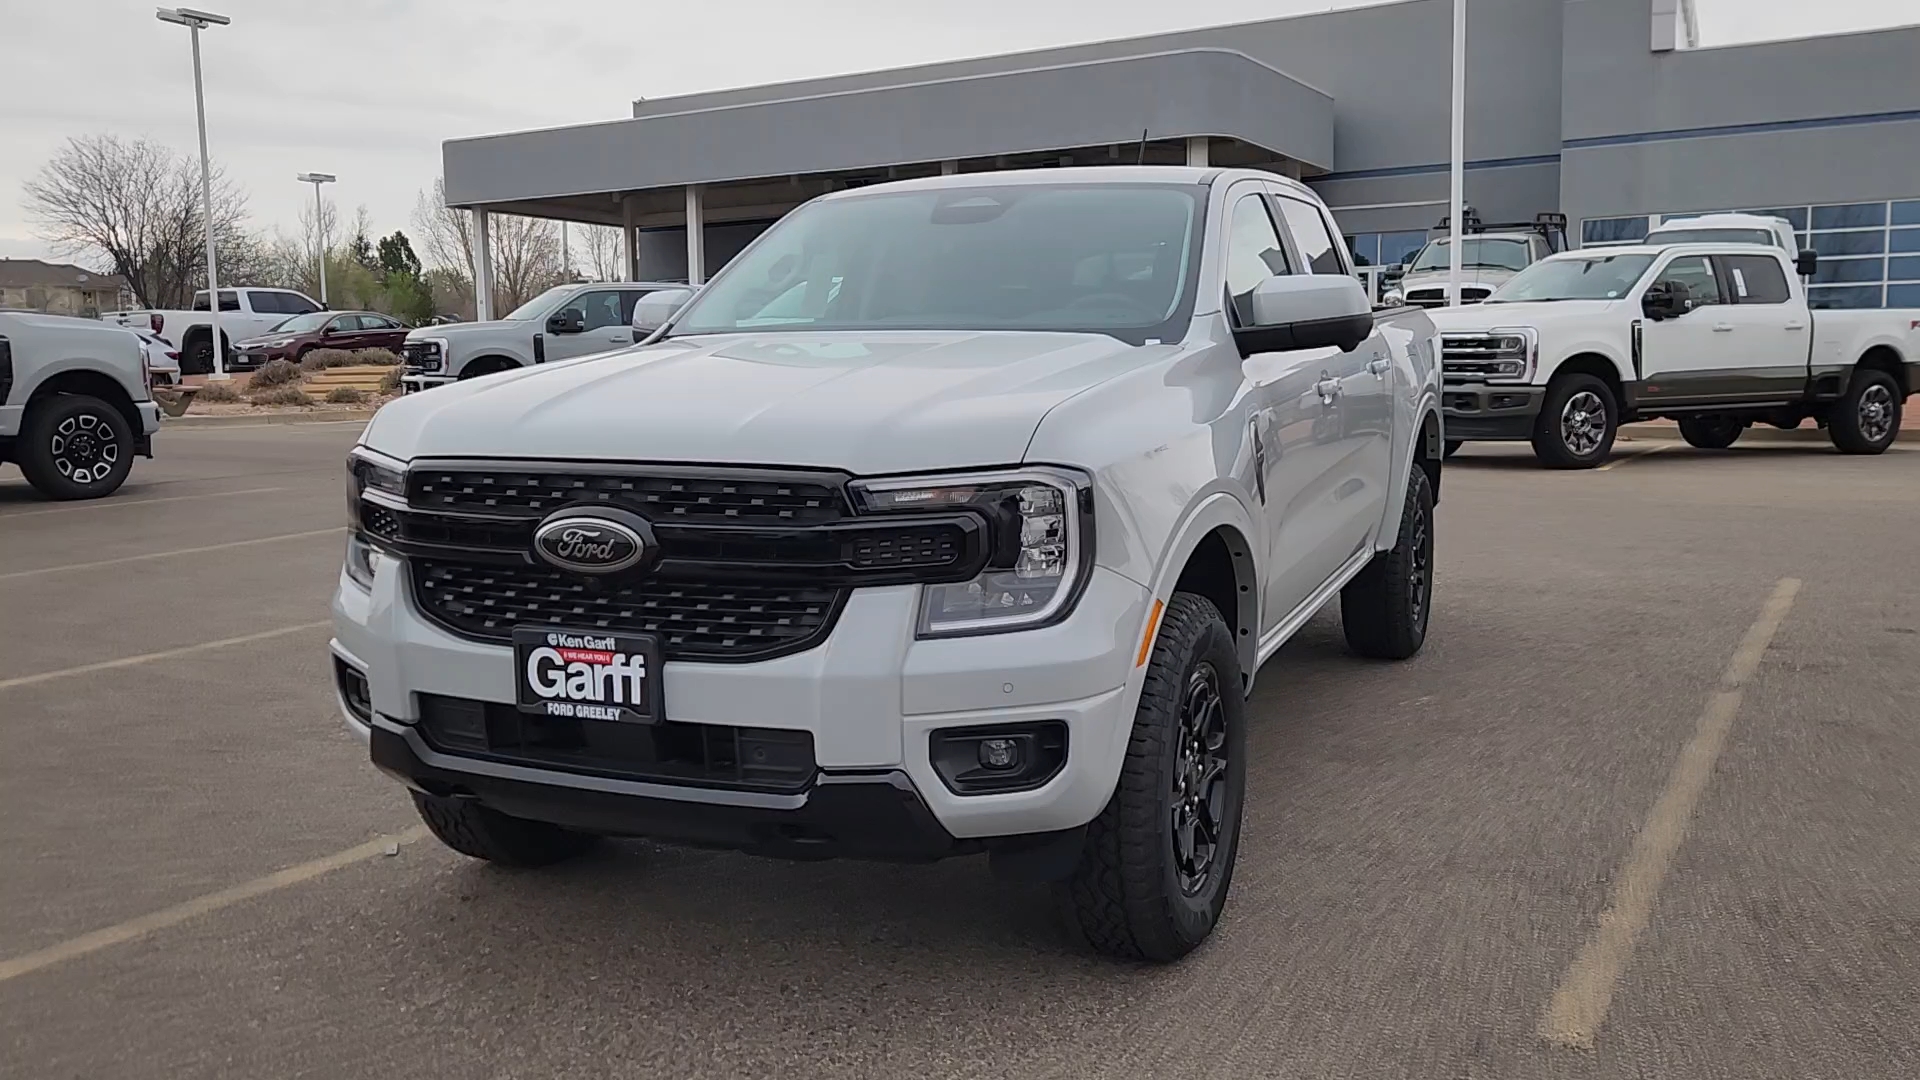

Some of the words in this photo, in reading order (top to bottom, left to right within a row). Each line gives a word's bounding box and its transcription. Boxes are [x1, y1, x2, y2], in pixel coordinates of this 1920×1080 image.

[557, 528, 615, 560] Ford
[558, 633, 583, 649] Ken
[583, 635, 616, 651] Garff
[568, 651, 577, 660] WE
[577, 652, 594, 661] HEAR
[594, 653, 606, 662] YOU
[527, 646, 646, 705] Garff
[547, 702, 574, 717] FORD
[575, 704, 621, 721] GREELEY
